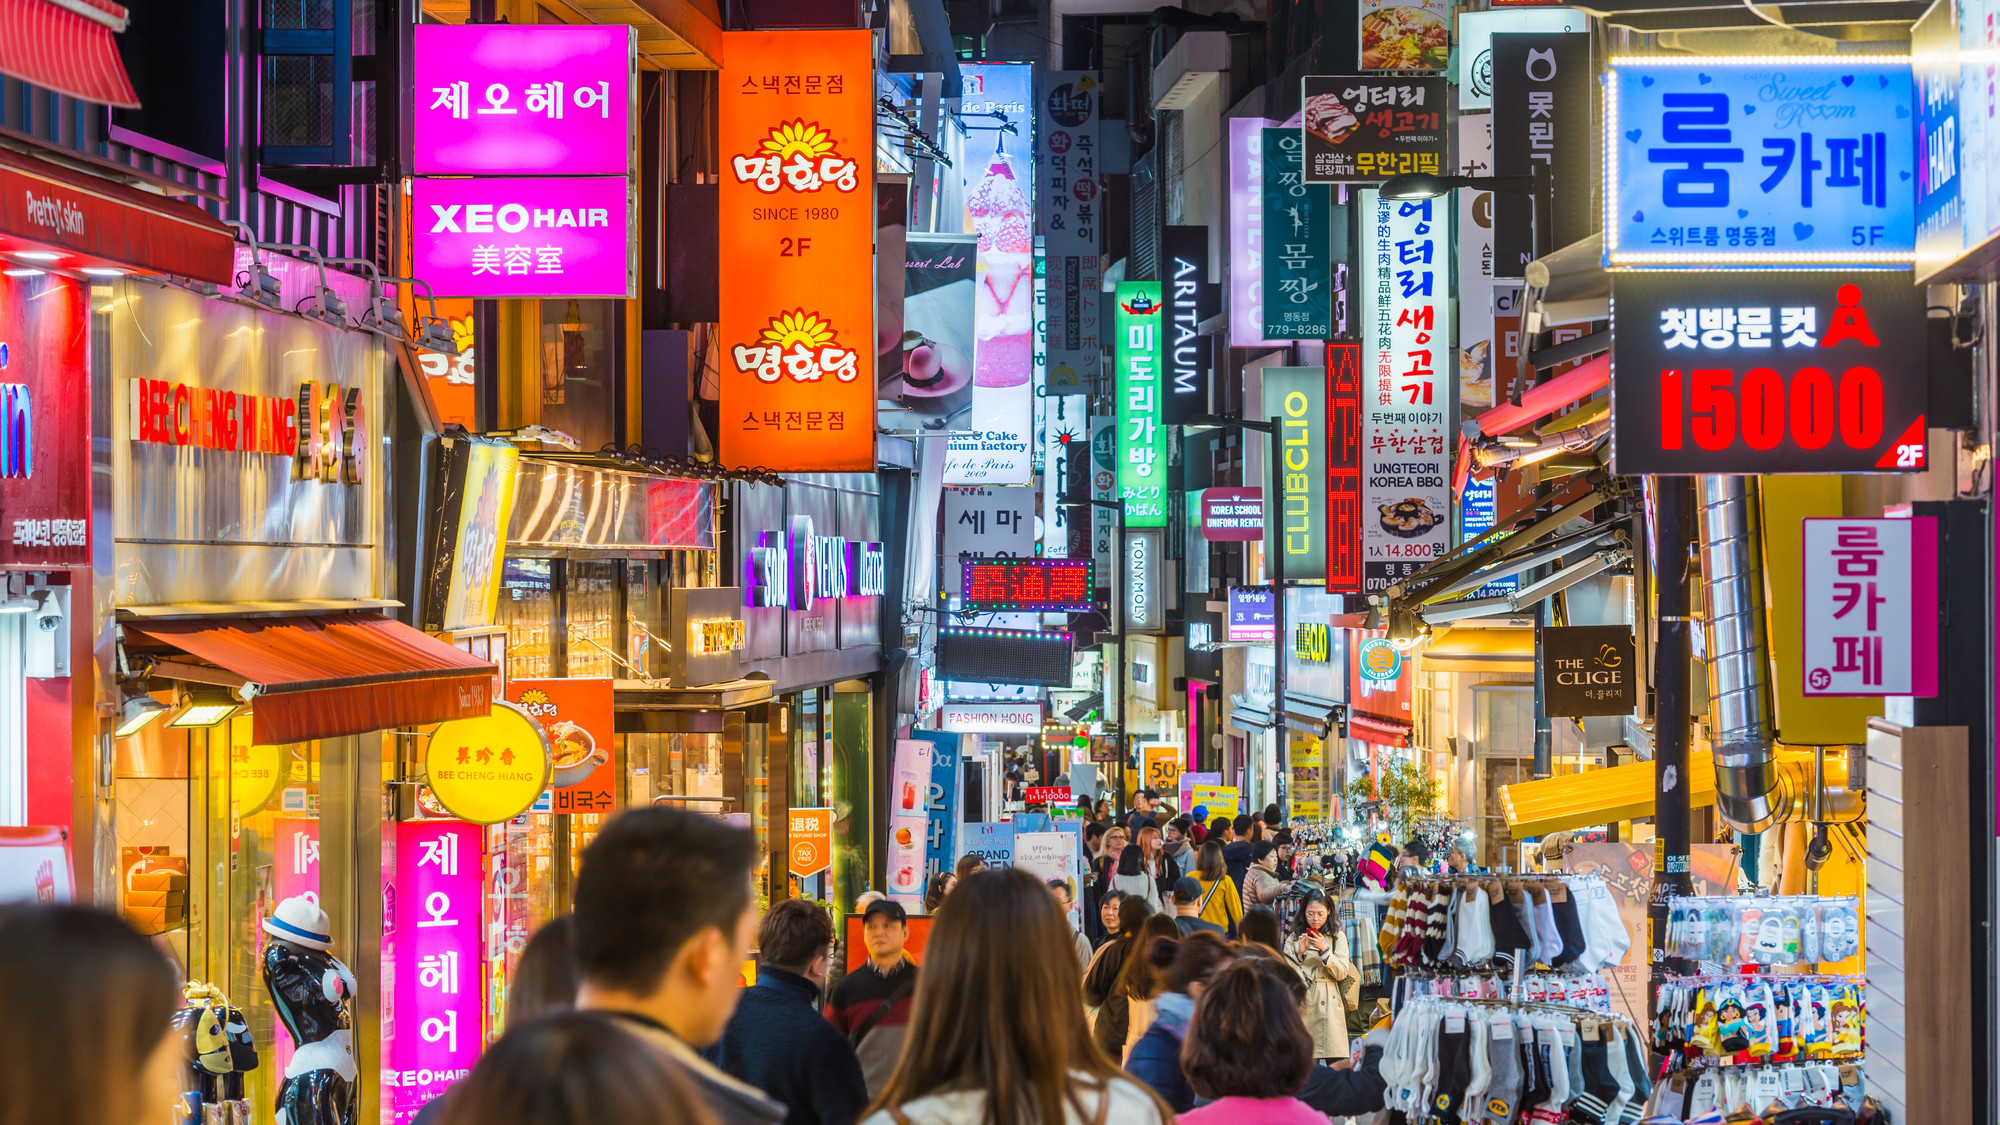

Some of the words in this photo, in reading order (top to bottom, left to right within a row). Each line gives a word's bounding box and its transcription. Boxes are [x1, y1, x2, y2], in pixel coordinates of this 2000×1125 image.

[741, 74, 844, 95] 스낵전문점
[1758, 72, 1836, 103] Sweet
[430, 80, 610, 119] 제오헤어
[962, 101, 980, 113] de
[1342, 85, 1426, 113] 엉터리
[1364, 109, 1439, 138] 생고기
[1315, 153, 1344, 164] 삼겹살
[1355, 151, 1439, 176] 무한리필
[733, 153, 860, 193] 명화당
[1314, 164, 1355, 175] 된장찌개
[1072, 135, 1099, 243] 즉석떡볶이
[752, 207, 799, 221] SINCE
[804, 207, 839, 220] 1980
[1650, 225, 1720, 246] 스위트룸
[1725, 226, 1776, 247] 명동점
[1851, 226, 1885, 246] 5F
[779, 237, 812, 257] 2F
[471, 243, 564, 276] 美容室
[934, 255, 966, 269] Lab
[1278, 243, 1319, 304] 몸짱
[1174, 256, 1197, 394] ARITAUM
[1283, 312, 1309, 322] 명동점
[1268, 325, 1327, 335] 779-8286
[1661, 307, 1773, 349] 첫방문
[1779, 305, 1818, 349] 컷
[733, 344, 860, 384] 명화당
[1128, 323, 1156, 477] 미도리가방
[1659, 366, 1884, 451] 15000
[138, 377, 170, 443] BEE
[173, 382, 238, 452] CHENG
[242, 393, 297, 457] HIANG
[742, 411, 844, 431] 스낵전문점
[1370, 412, 1406, 425] 두번째
[1408, 411, 1442, 425] 이야기
[986, 430, 1018, 441] Cake
[1370, 435, 1444, 455] 무한삼겹
[981, 441, 1028, 453] factory
[1896, 444, 1923, 467] 2F
[980, 458, 1014, 470] Paris
[1373, 463, 1440, 474] UNGTEORI
[964, 470, 987, 478] 2009
[1369, 476, 1417, 488] KOREA
[1419, 476, 1444, 488] BBQ
[1122, 486, 1161, 500] みどり
[1124, 502, 1162, 517] かばん
[1211, 505, 1234, 515] KOREA
[1235, 504, 1262, 515] SCHOOL
[1207, 518, 1239, 528] UNIFORM
[814, 536, 848, 600] VENUS
[1132, 539, 1146, 622] TONYMOLY
[1831, 526, 1886, 686] 룸카페
[1554, 658, 1585, 669] THE
[1556, 670, 1622, 686] CLIGE
[1811, 671, 1829, 687] 5F
[949, 713, 997, 724] FASHION
[1001, 713, 1034, 724] HONG
[437, 770, 454, 780] BEE
[457, 770, 495, 781] CHENG
[498, 770, 533, 782] HIANG
[553, 791, 612, 810] 비국수
[791, 817, 819, 832] 退税
[967, 849, 1010, 860] GRAND
[416, 831, 459, 1053] 제오헤어
